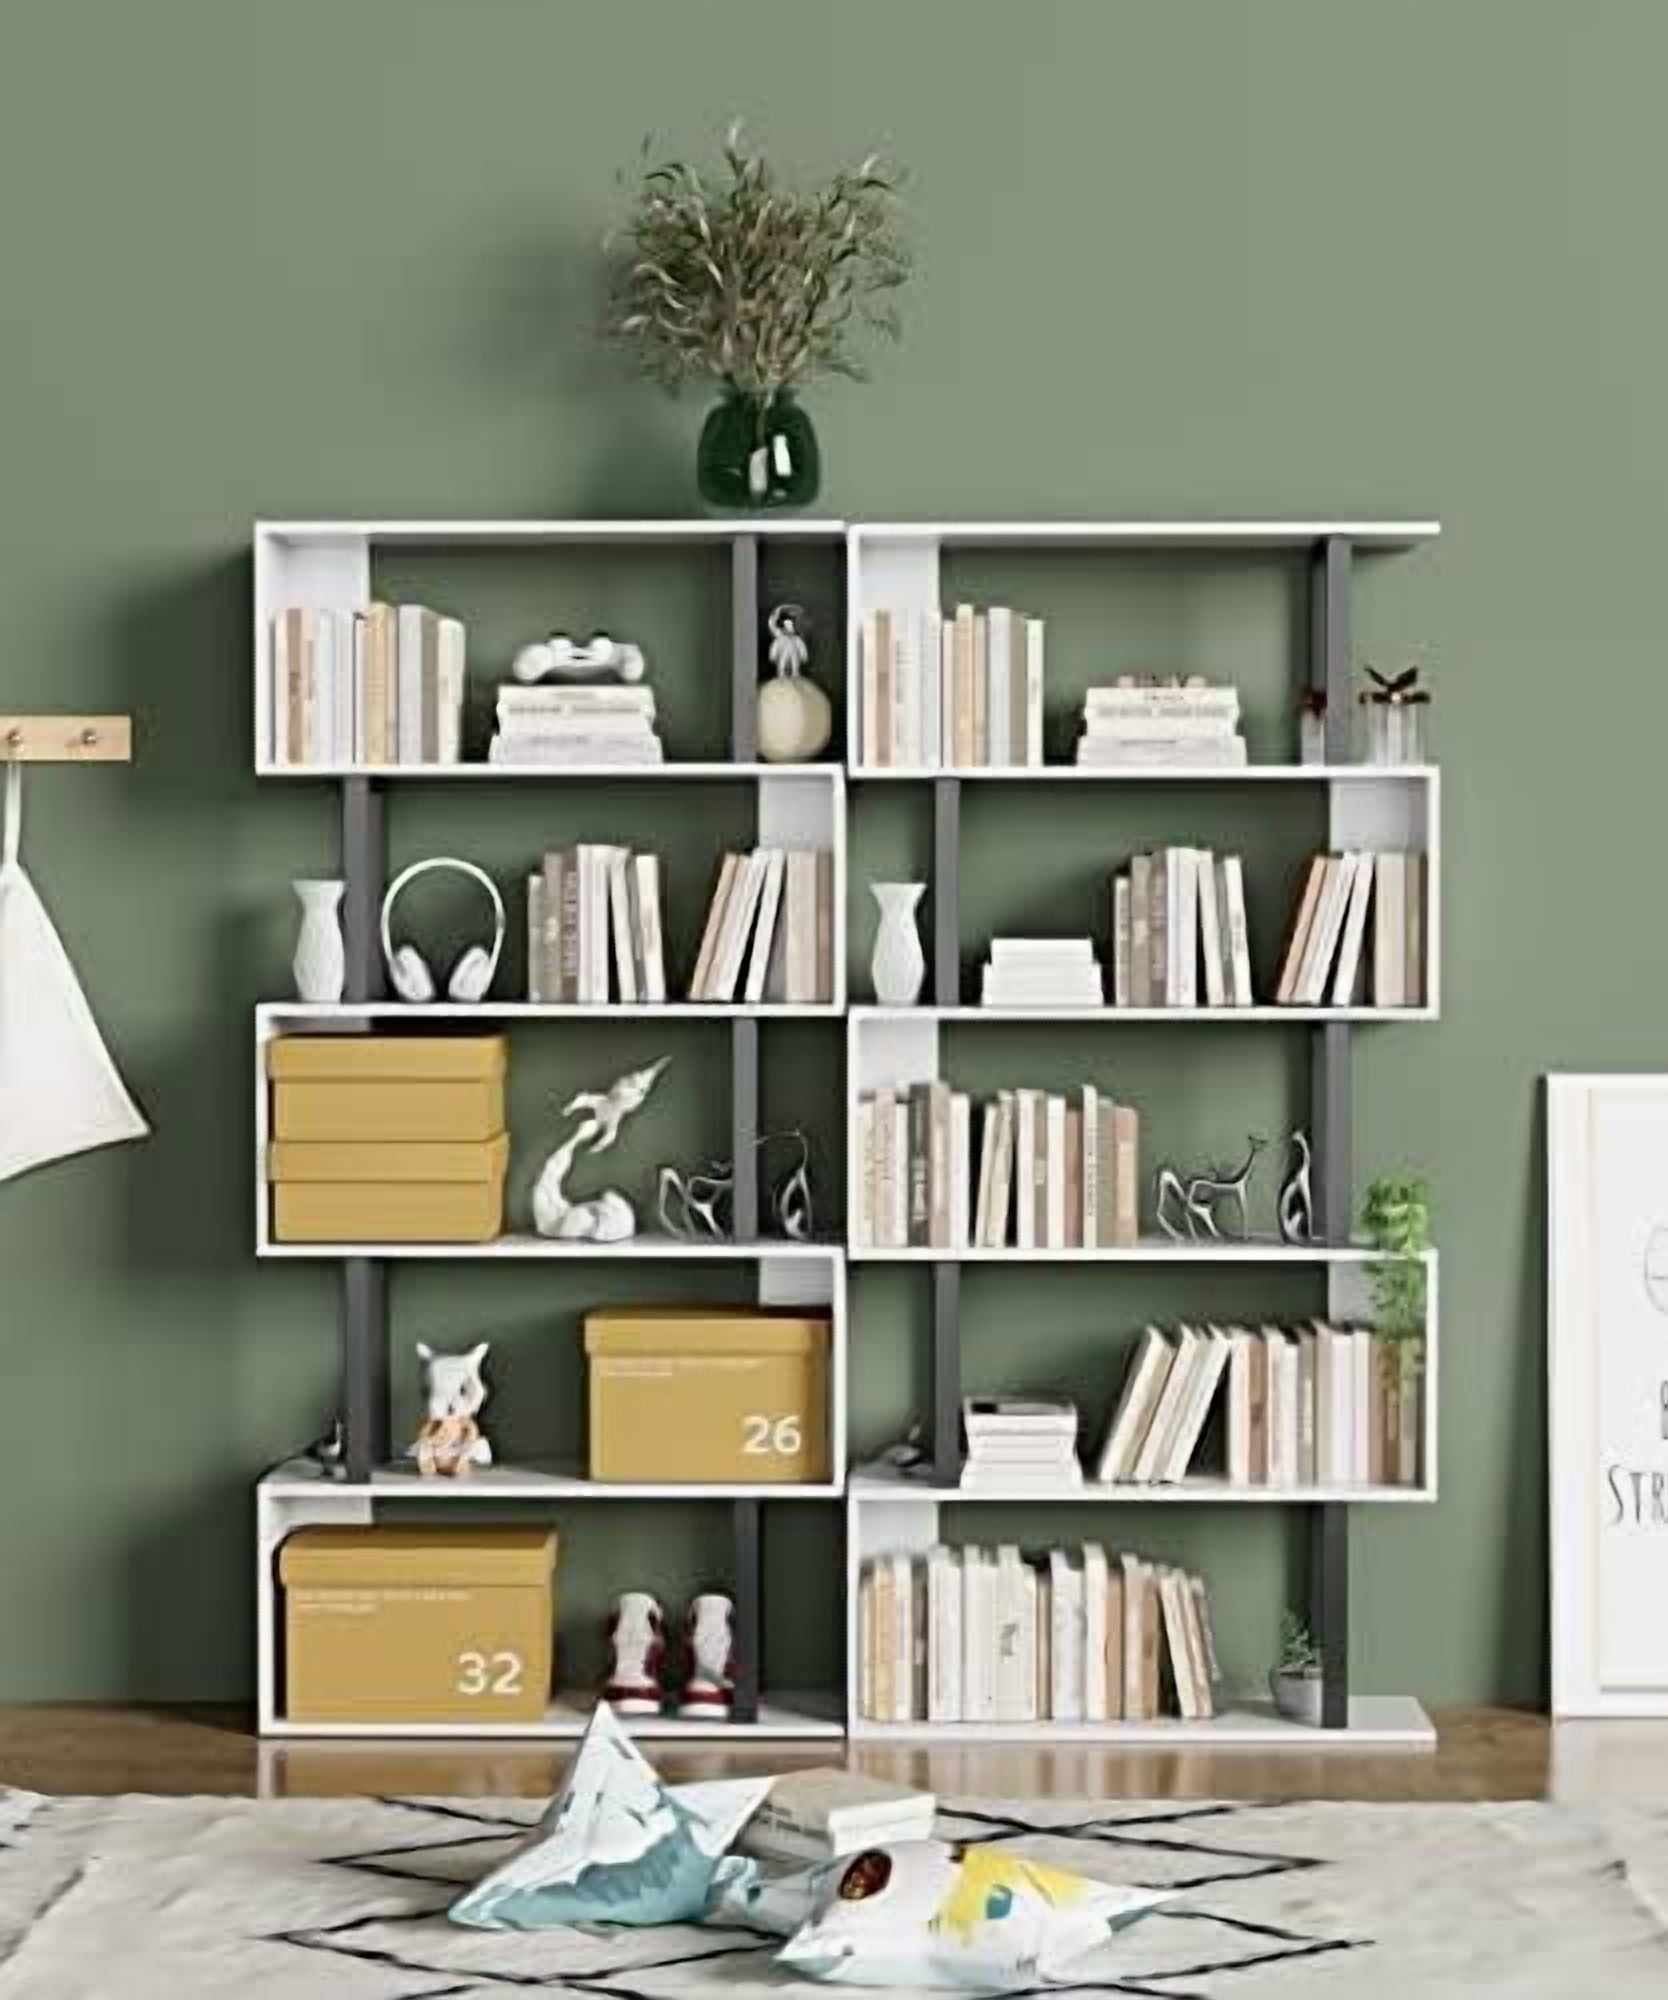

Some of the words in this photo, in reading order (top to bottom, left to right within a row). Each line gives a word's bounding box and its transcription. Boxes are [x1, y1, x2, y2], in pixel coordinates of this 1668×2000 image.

[742, 1415, 801, 1455] 26
[1607, 1463, 1668, 1526] STR
[457, 1652, 523, 1696] 32
